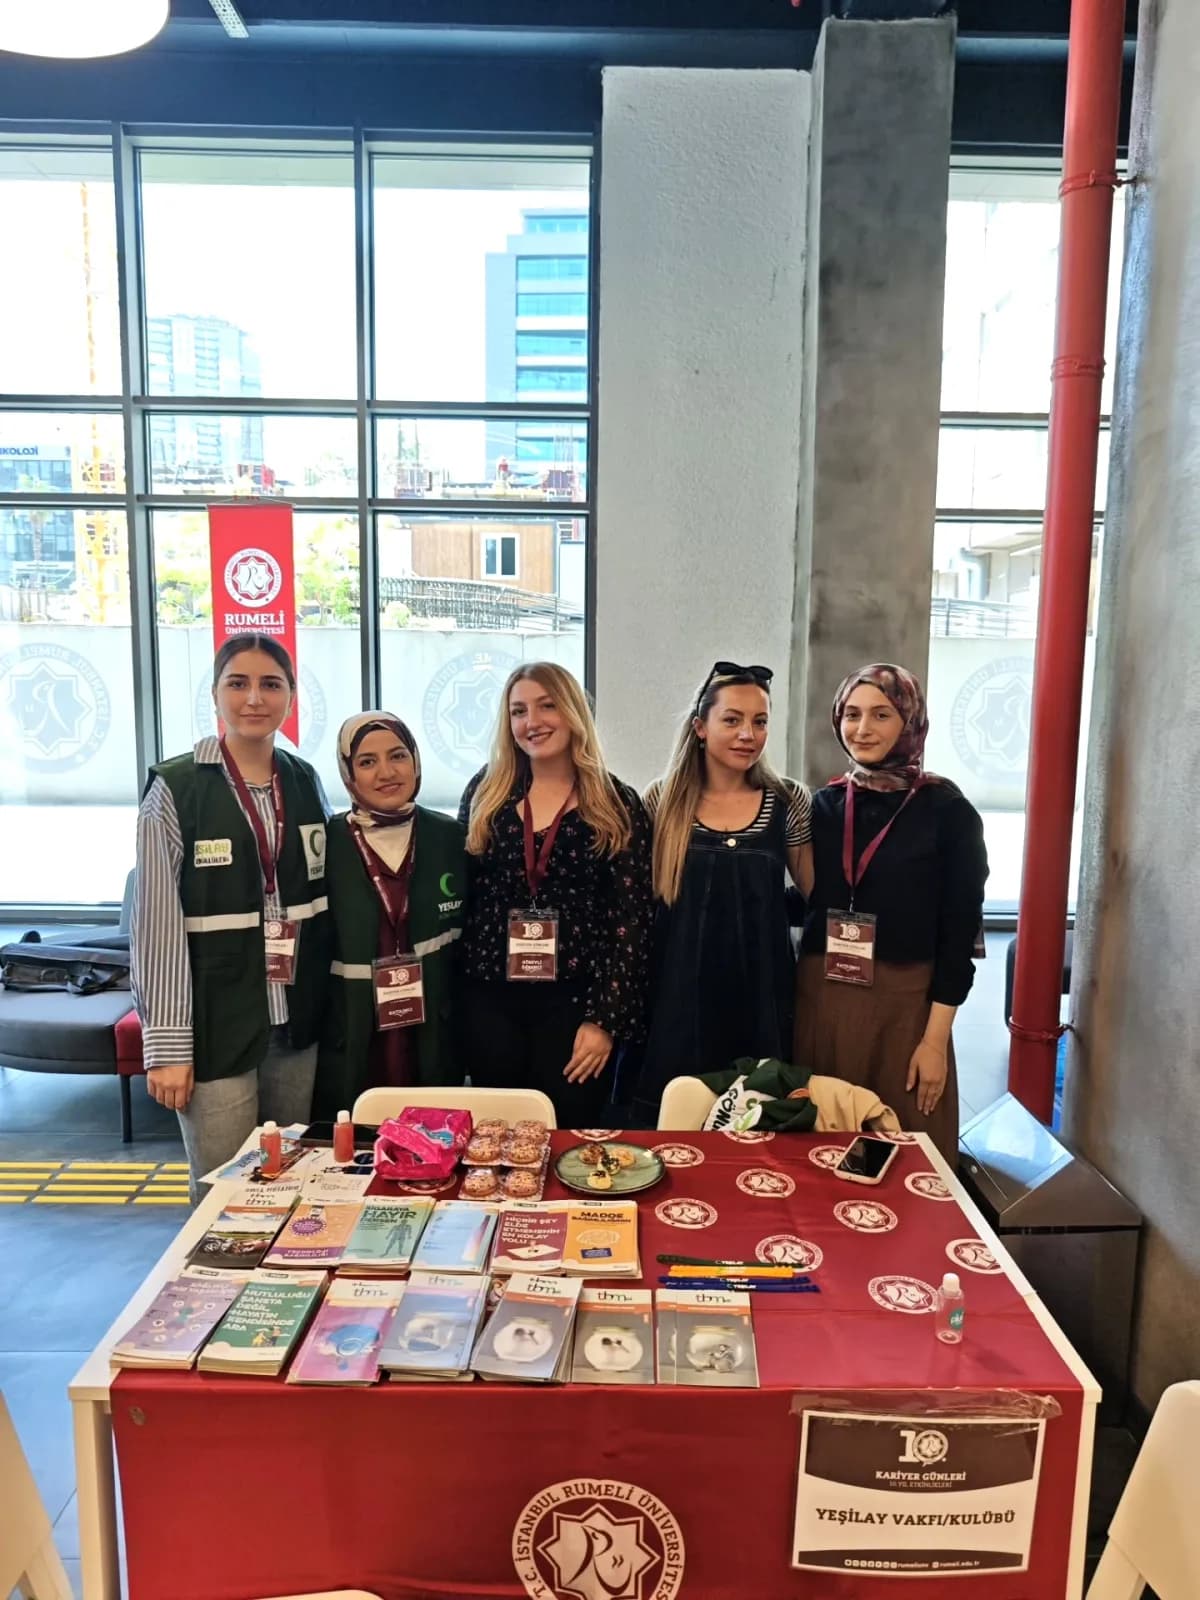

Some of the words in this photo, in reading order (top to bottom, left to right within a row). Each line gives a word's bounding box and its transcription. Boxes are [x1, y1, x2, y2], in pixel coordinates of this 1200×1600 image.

[223, 610, 285, 625] RUMELİ
[362, 1210, 417, 1219] HAYIR
[222, 1323, 247, 1331] ARA
[875, 1470, 920, 1480] KARİYER
[922, 1472, 966, 1481] GÜNLERİ
[562, 1483, 635, 1501] RUMELİ
[816, 1508, 889, 1526] YEŞİLAY
[892, 1509, 1016, 1527] VAKFI/KULÜBÜ
[515, 1492, 560, 1562] İSTANBUL
[638, 1493, 683, 1600] ÜNİVERSİTES
[524, 1567, 546, 1598] T.C.
